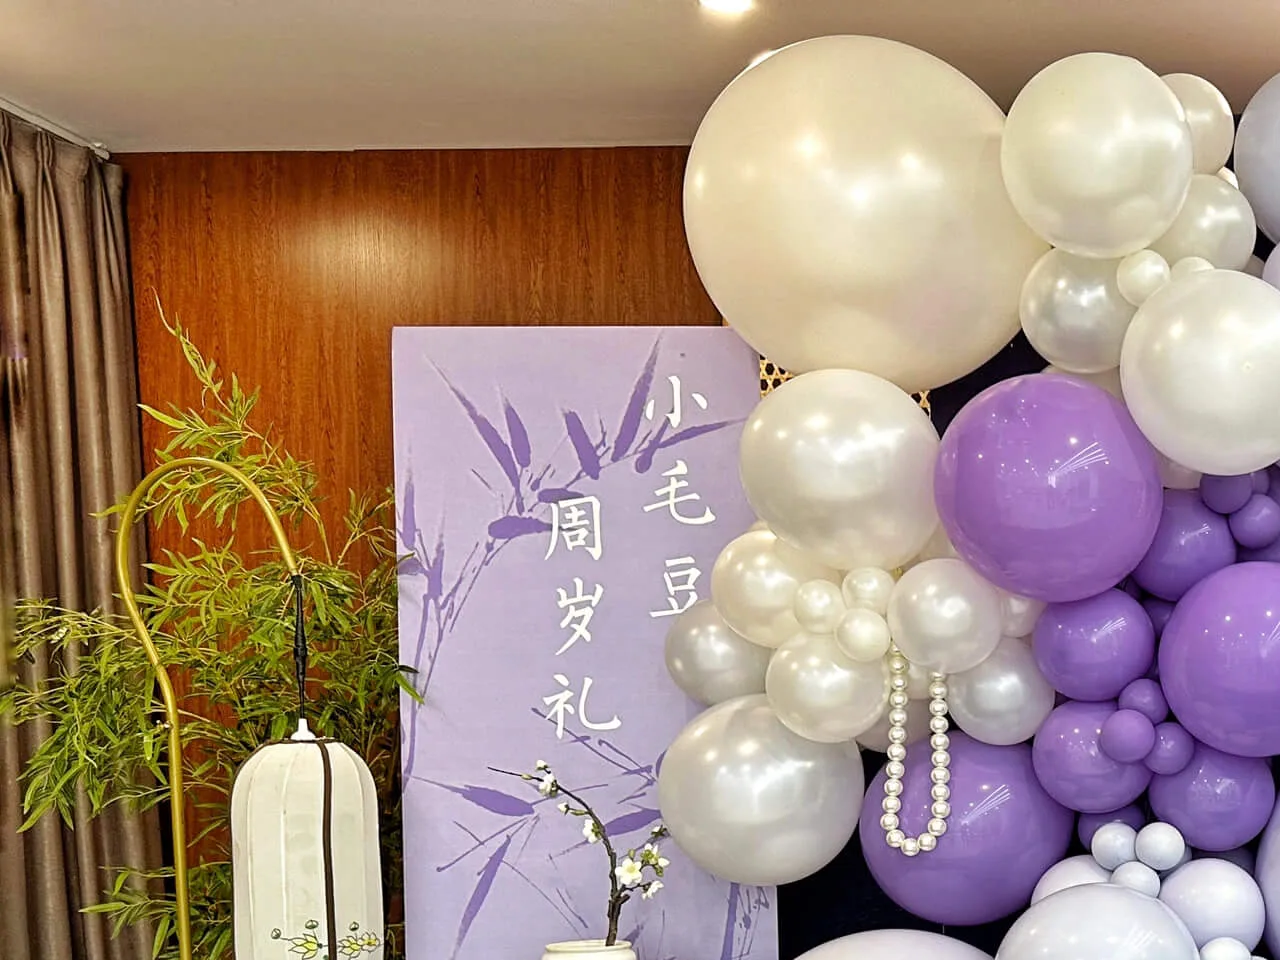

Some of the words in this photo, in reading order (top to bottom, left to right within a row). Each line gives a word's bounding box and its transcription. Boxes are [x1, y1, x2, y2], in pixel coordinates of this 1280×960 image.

[541, 495, 622, 740] 周岁礼
[643, 375, 716, 618] 小毛豆
